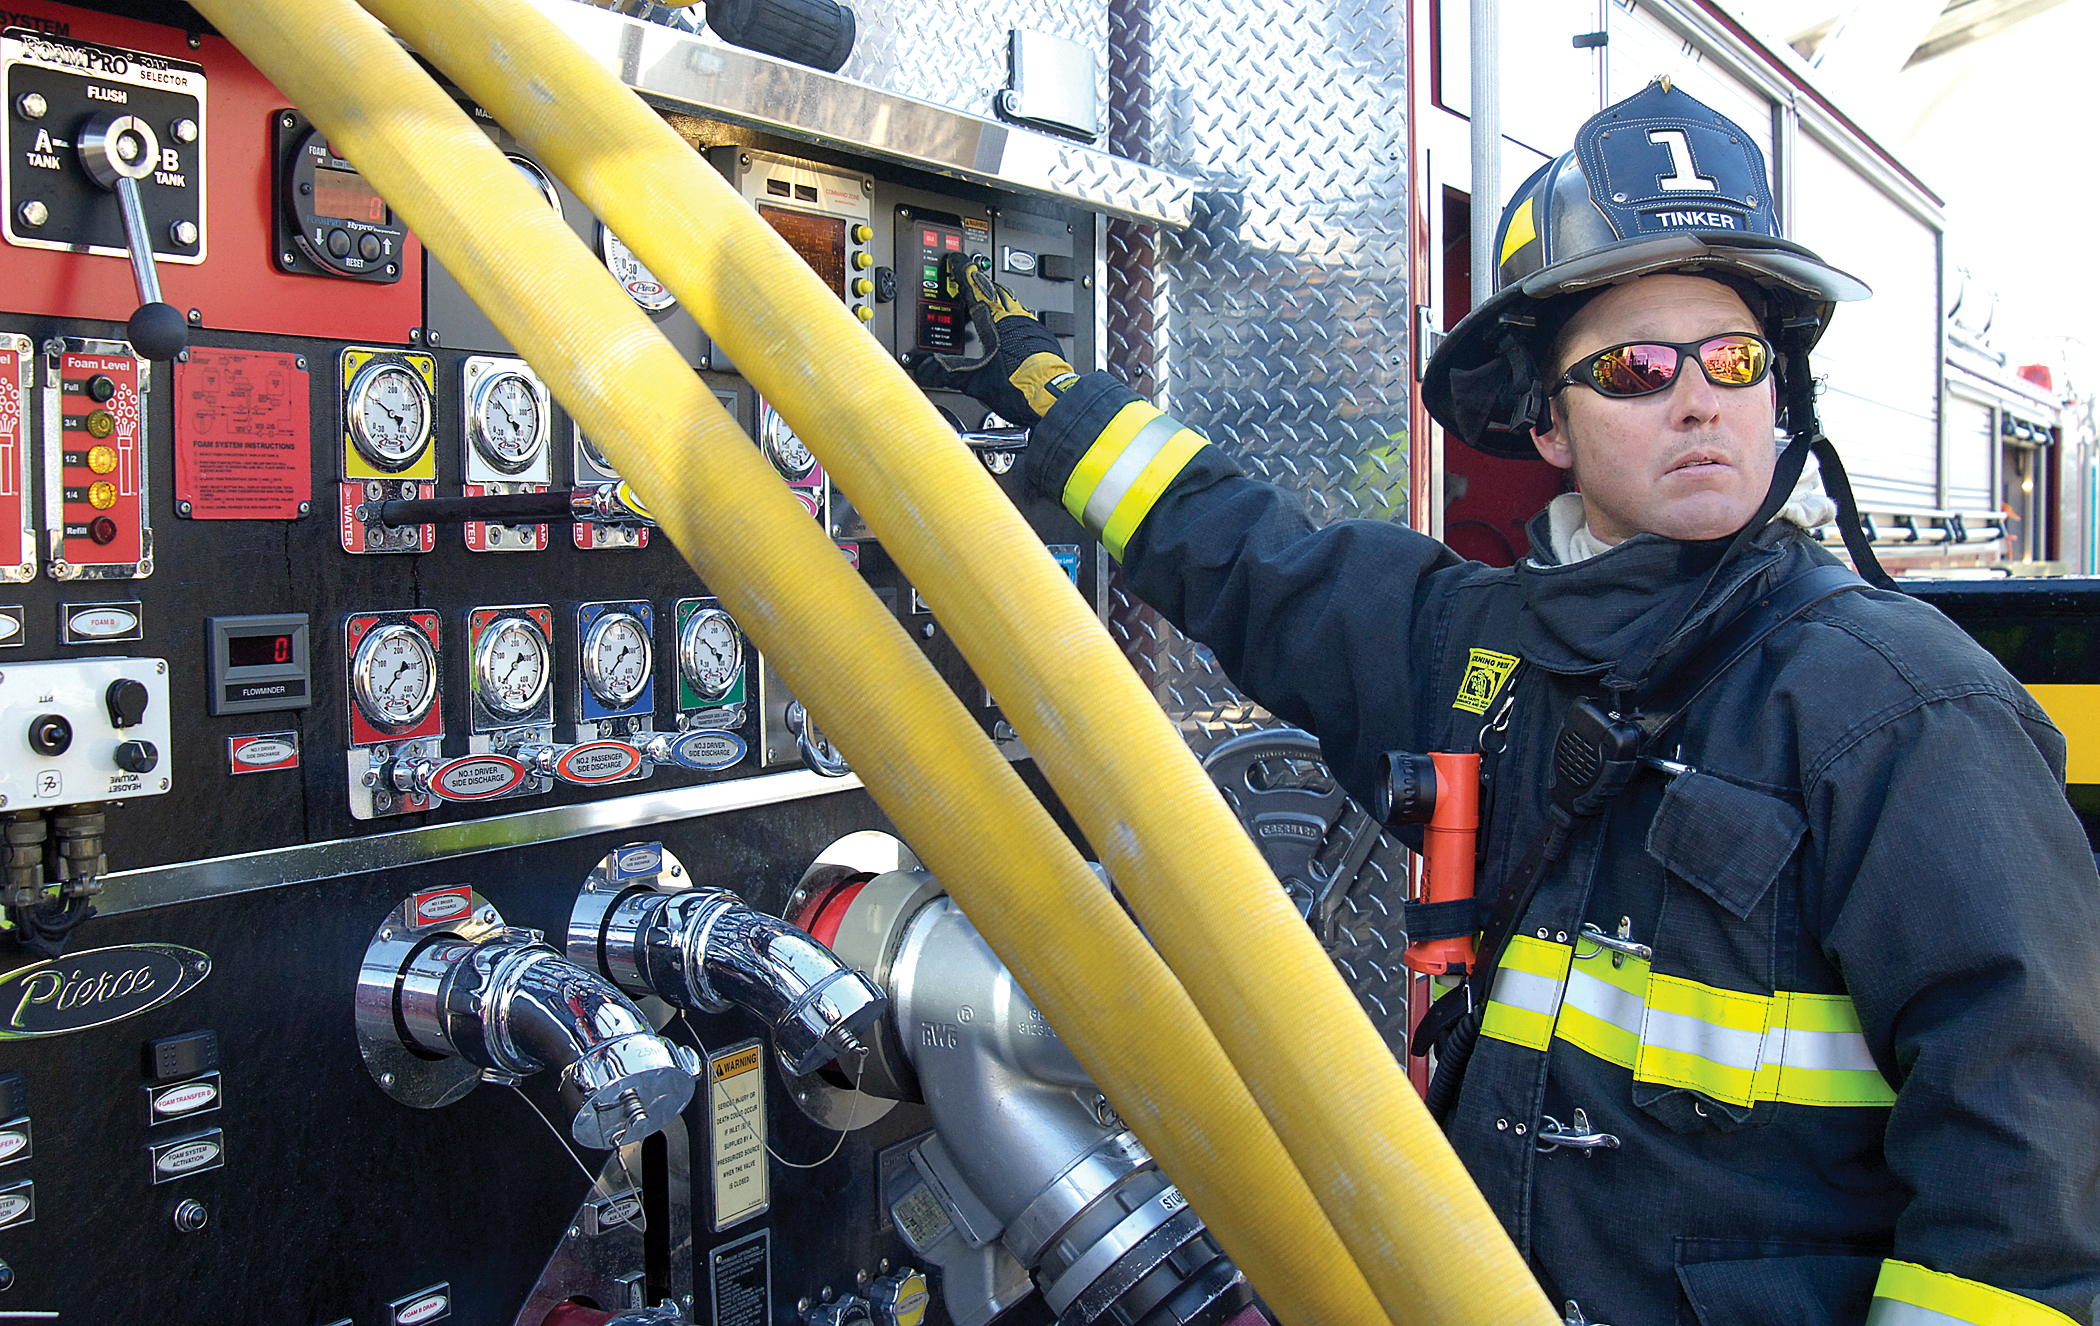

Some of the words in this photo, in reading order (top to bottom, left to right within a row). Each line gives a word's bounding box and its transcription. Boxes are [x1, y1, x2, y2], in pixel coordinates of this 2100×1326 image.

[0, 10, 70, 37] SYSTEM
[139, 70, 189, 88] SELECTOR
[87, 85, 128, 104] FLUSH
[34, 128, 54, 154] A
[308, 145, 327, 157] FOAM
[26, 152, 60, 170] TANK
[161, 148, 180, 172] B
[1649, 131, 1719, 191] 1
[154, 171, 187, 188] TANK
[369, 196, 383, 220] 0
[1655, 213, 1735, 230] TINKER
[346, 257, 364, 269] RESET
[67, 356, 99, 370] Foam
[101, 359, 130, 372] Level
[64, 383, 79, 391] Full
[64, 419, 77, 427] 3/4
[215, 441, 243, 449] SYSTEM
[244, 443, 296, 451] INSTRUCTIONS
[65, 455, 78, 463] 1/2
[66, 491, 78, 499] 1/4
[66, 526, 87, 535] Refill
[343, 504, 354, 547] WATER
[90, 619, 109, 627] FOAM
[274, 638, 288, 662] 0
[393, 647, 404, 655] 200
[377, 660, 387, 668] 100
[242, 686, 286, 697] FLOWMINDER
[38, 695, 54, 704] PTT
[256, 751, 280, 759] DISCHARGE
[576, 757, 589, 765] NO.2
[591, 752, 623, 762] PASSENGER
[701, 749, 730, 757] DISCHARGE
[458, 770, 473, 778] NO.1
[474, 766, 498, 776] DRIVER
[577, 764, 590, 773] SIDE
[590, 760, 622, 771] DISCHARGE
[110, 774, 140, 784] VOLUME
[452, 778, 467, 788] SIDE
[468, 773, 505, 786] DISCHARGE
[108, 783, 142, 793] HEADSET
[1263, 823, 1317, 837] EBERHARD
[11, 965, 156, 1028] Pierce
[723, 1053, 757, 1074] WARNING
[159, 1099, 175, 1108] FOAM
[175, 1091, 206, 1103] TRANSFER
[749, 1091, 756, 1099] OR
[717, 1115, 730, 1126] DEATH
[744, 1104, 758, 1115] OCCUR
[724, 1137, 743, 1151] SUPPLIED
[168, 1152, 184, 1162] FOAM
[185, 1145, 208, 1157] SYSTEM
[717, 1150, 744, 1168] PRESSURIZED
[744, 1144, 760, 1157] SOURCE
[172, 1154, 204, 1168] ACTIVATION
[723, 1168, 735, 1178] WHEN
[735, 1164, 743, 1174] THE
[743, 1159, 756, 1170] VALVE
[404, 1309, 418, 1319] FOAM
[422, 1301, 438, 1312] DRAIN
